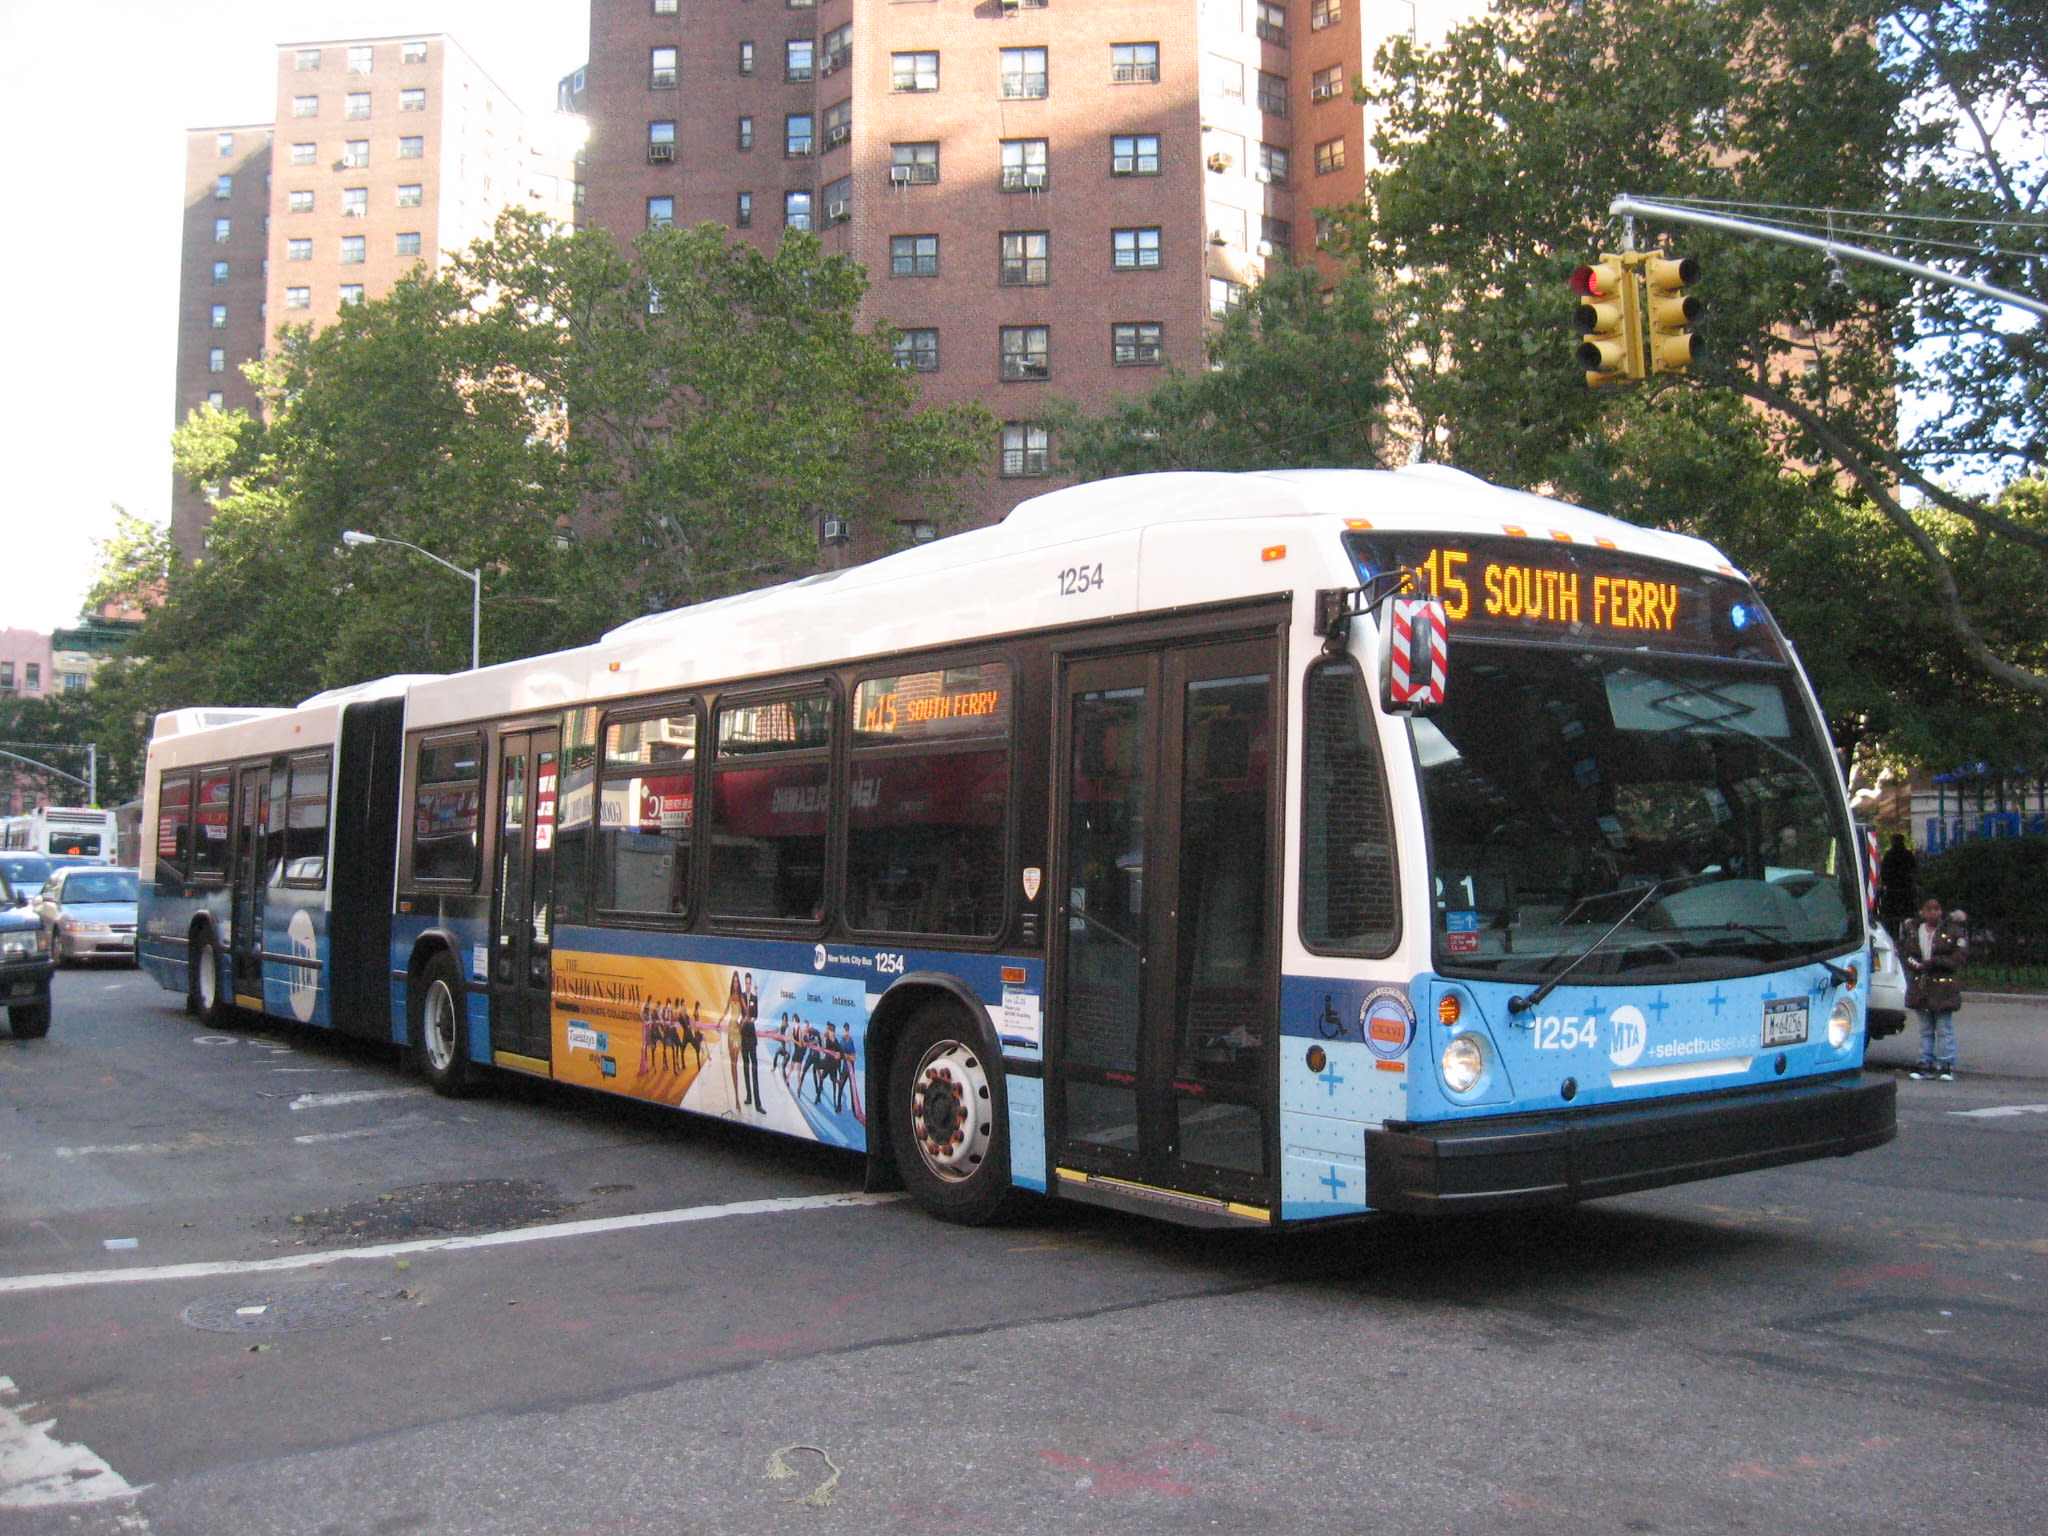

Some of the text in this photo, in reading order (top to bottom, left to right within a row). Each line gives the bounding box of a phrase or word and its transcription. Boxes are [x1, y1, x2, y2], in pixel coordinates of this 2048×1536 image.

[1057, 562, 1105, 596] 1254
[1484, 564, 1579, 622] SOUTH
[1594, 576, 1677, 630] FERRY
[864, 690, 998, 733] M15 SOUTH FERRY
[828, 953, 838, 962] New
[839, 954, 850, 964] York
[851, 955, 861, 966] City
[875, 952, 904, 974] 1254
[556, 975, 643, 1006] FASHION SHOW
[570, 1028, 595, 1048] Tuesdays
[1533, 1016, 1598, 1049] 1254
